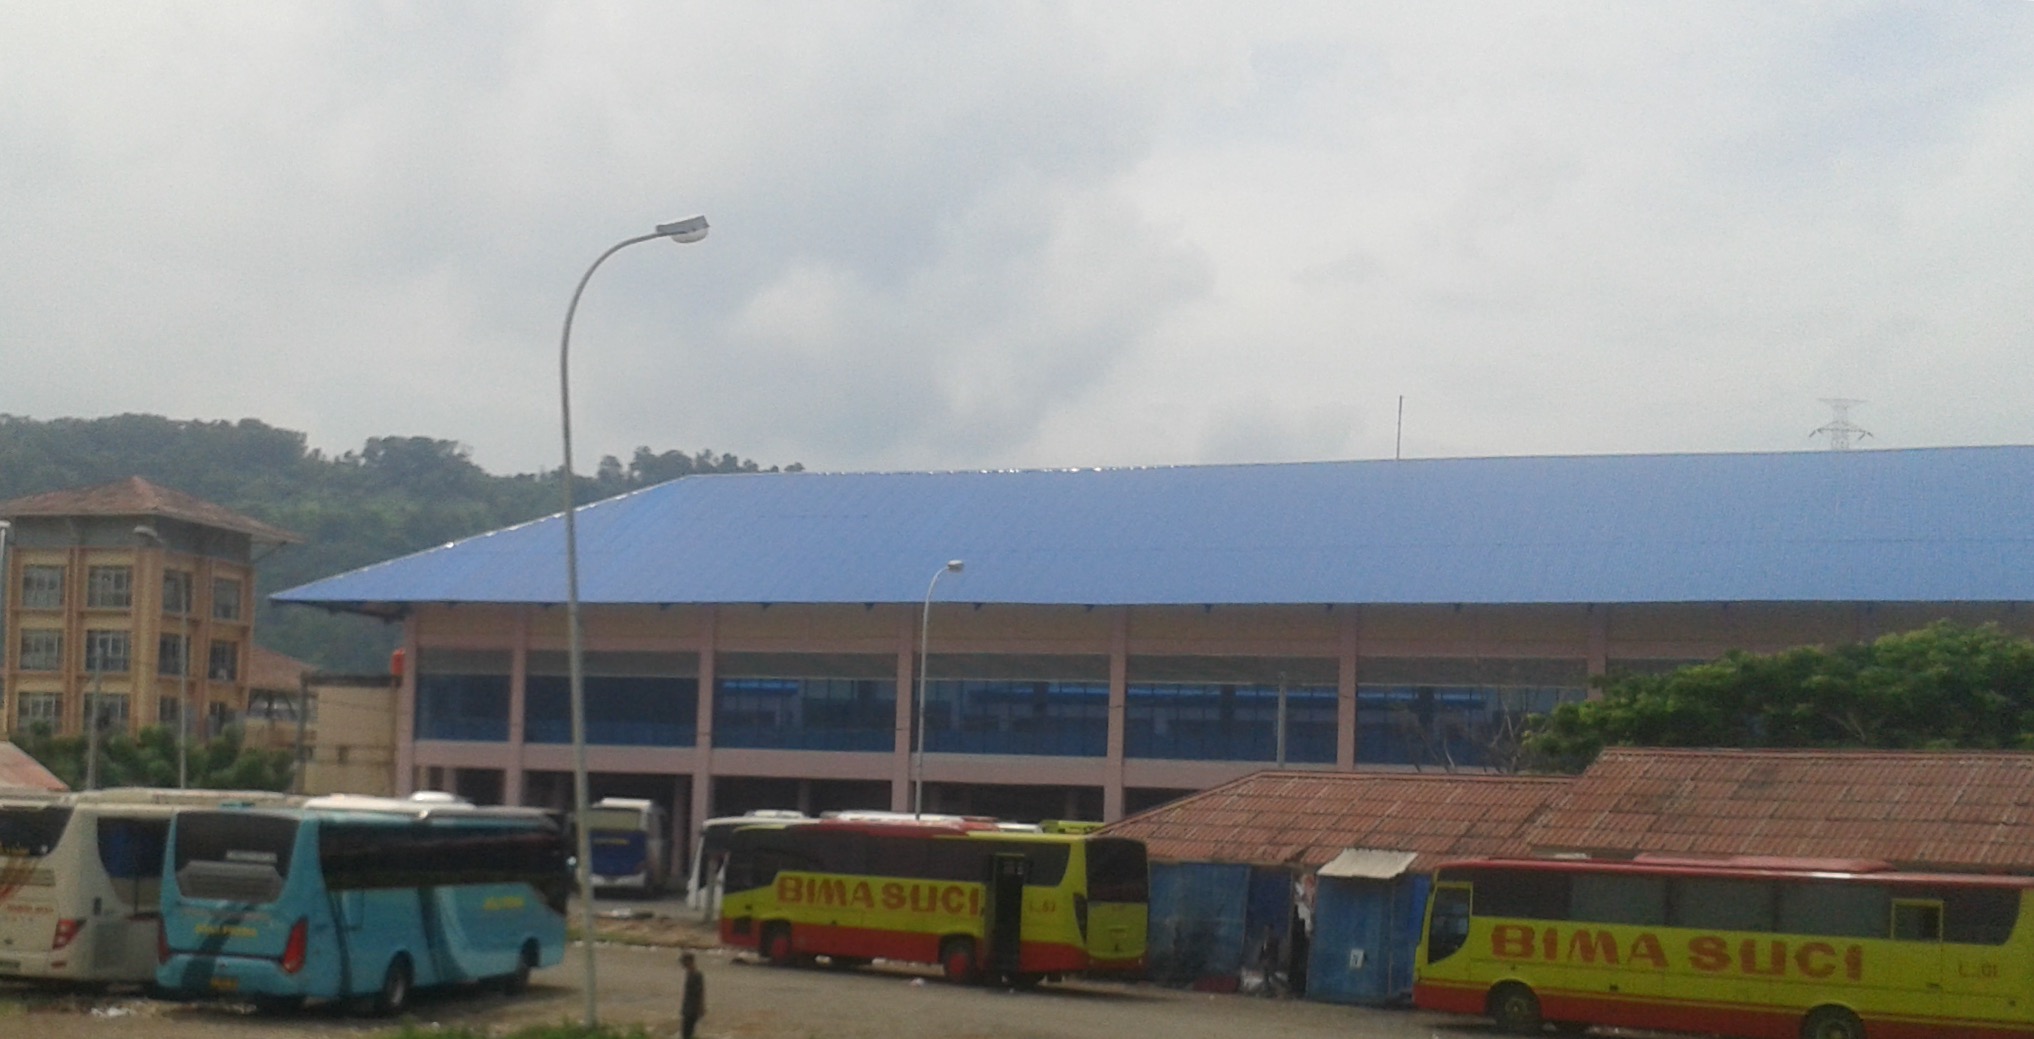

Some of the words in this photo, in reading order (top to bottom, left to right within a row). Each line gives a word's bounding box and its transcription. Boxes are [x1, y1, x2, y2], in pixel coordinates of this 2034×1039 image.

[776, 876, 875, 909] BIMA
[880, 881, 981, 917] SUCI
[1491, 923, 1670, 969] BIMA
[1687, 934, 1864, 982] SUCI
